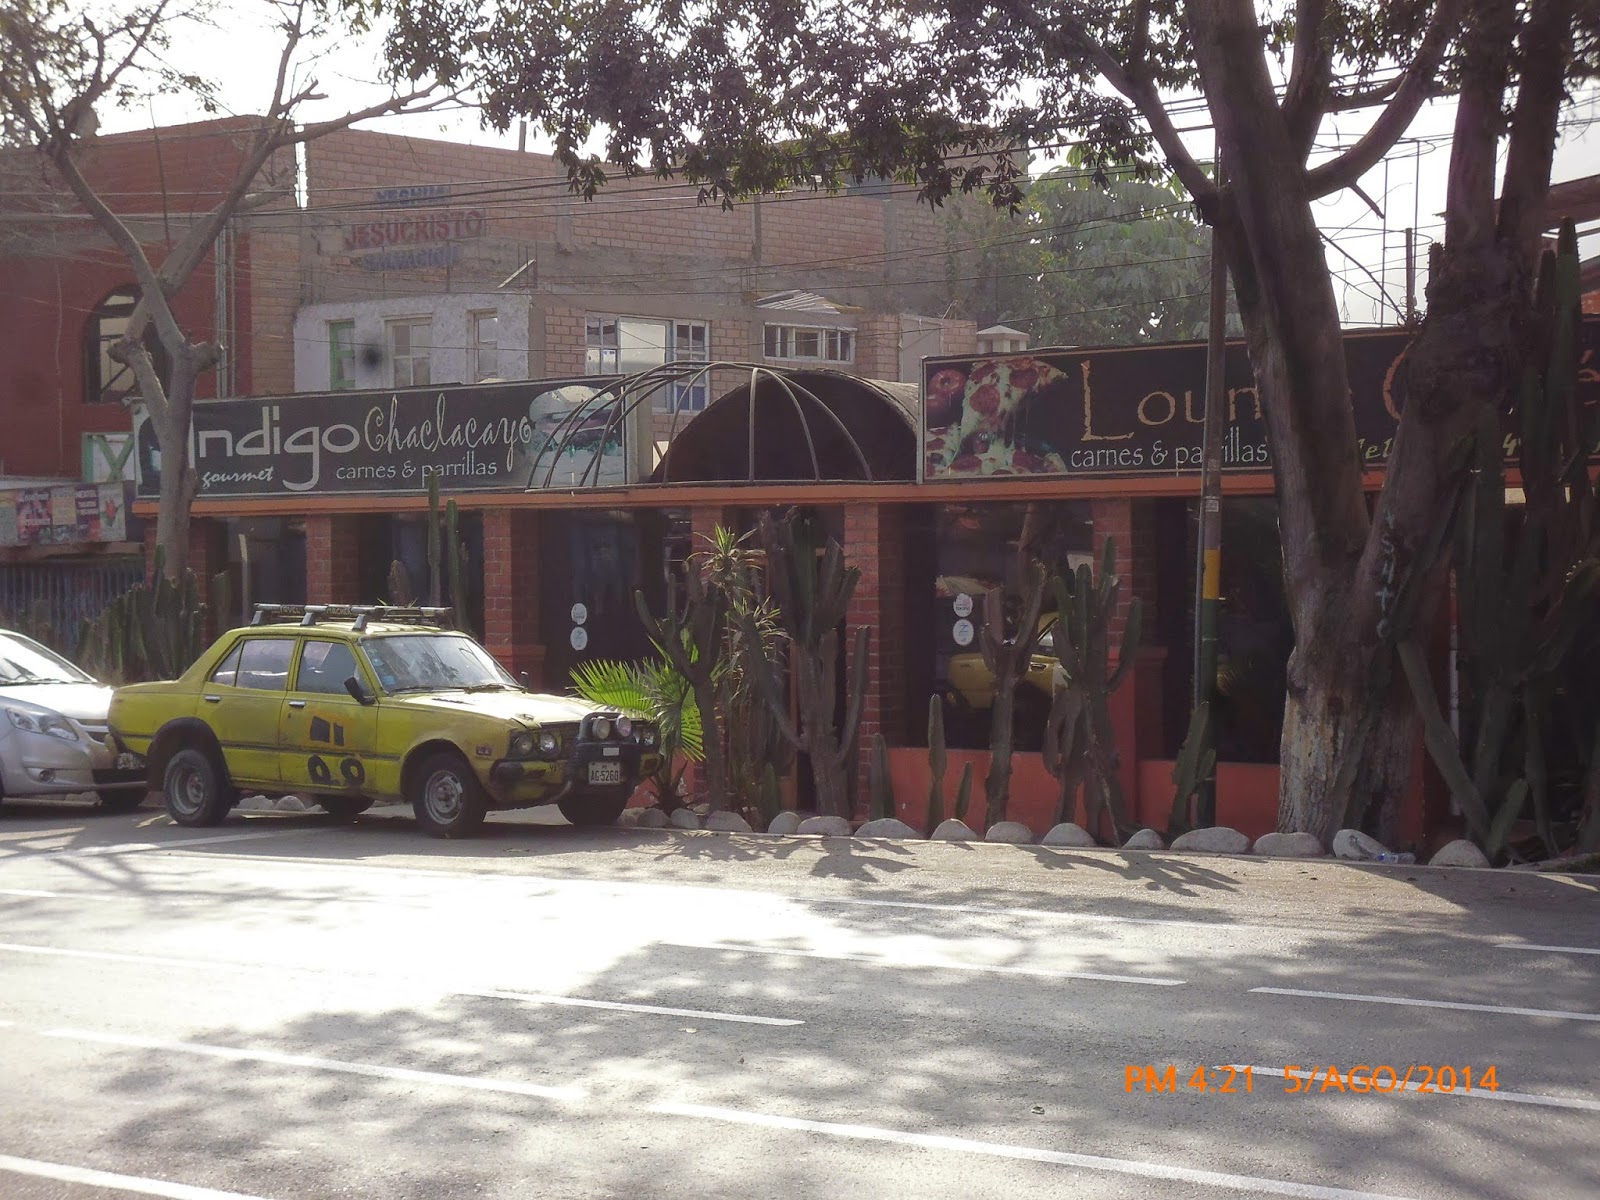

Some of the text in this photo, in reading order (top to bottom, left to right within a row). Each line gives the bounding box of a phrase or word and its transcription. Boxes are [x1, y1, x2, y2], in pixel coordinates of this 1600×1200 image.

[344, 210, 483, 250] JESUCRISTO
[1081, 359, 1262, 442] Loun
[364, 392, 532, 473] Chaclacayo
[1071, 426, 1268, 477] carnes & paillas
[202, 466, 274, 490] gourmet
[336, 450, 498, 488] carnes & parrillas
